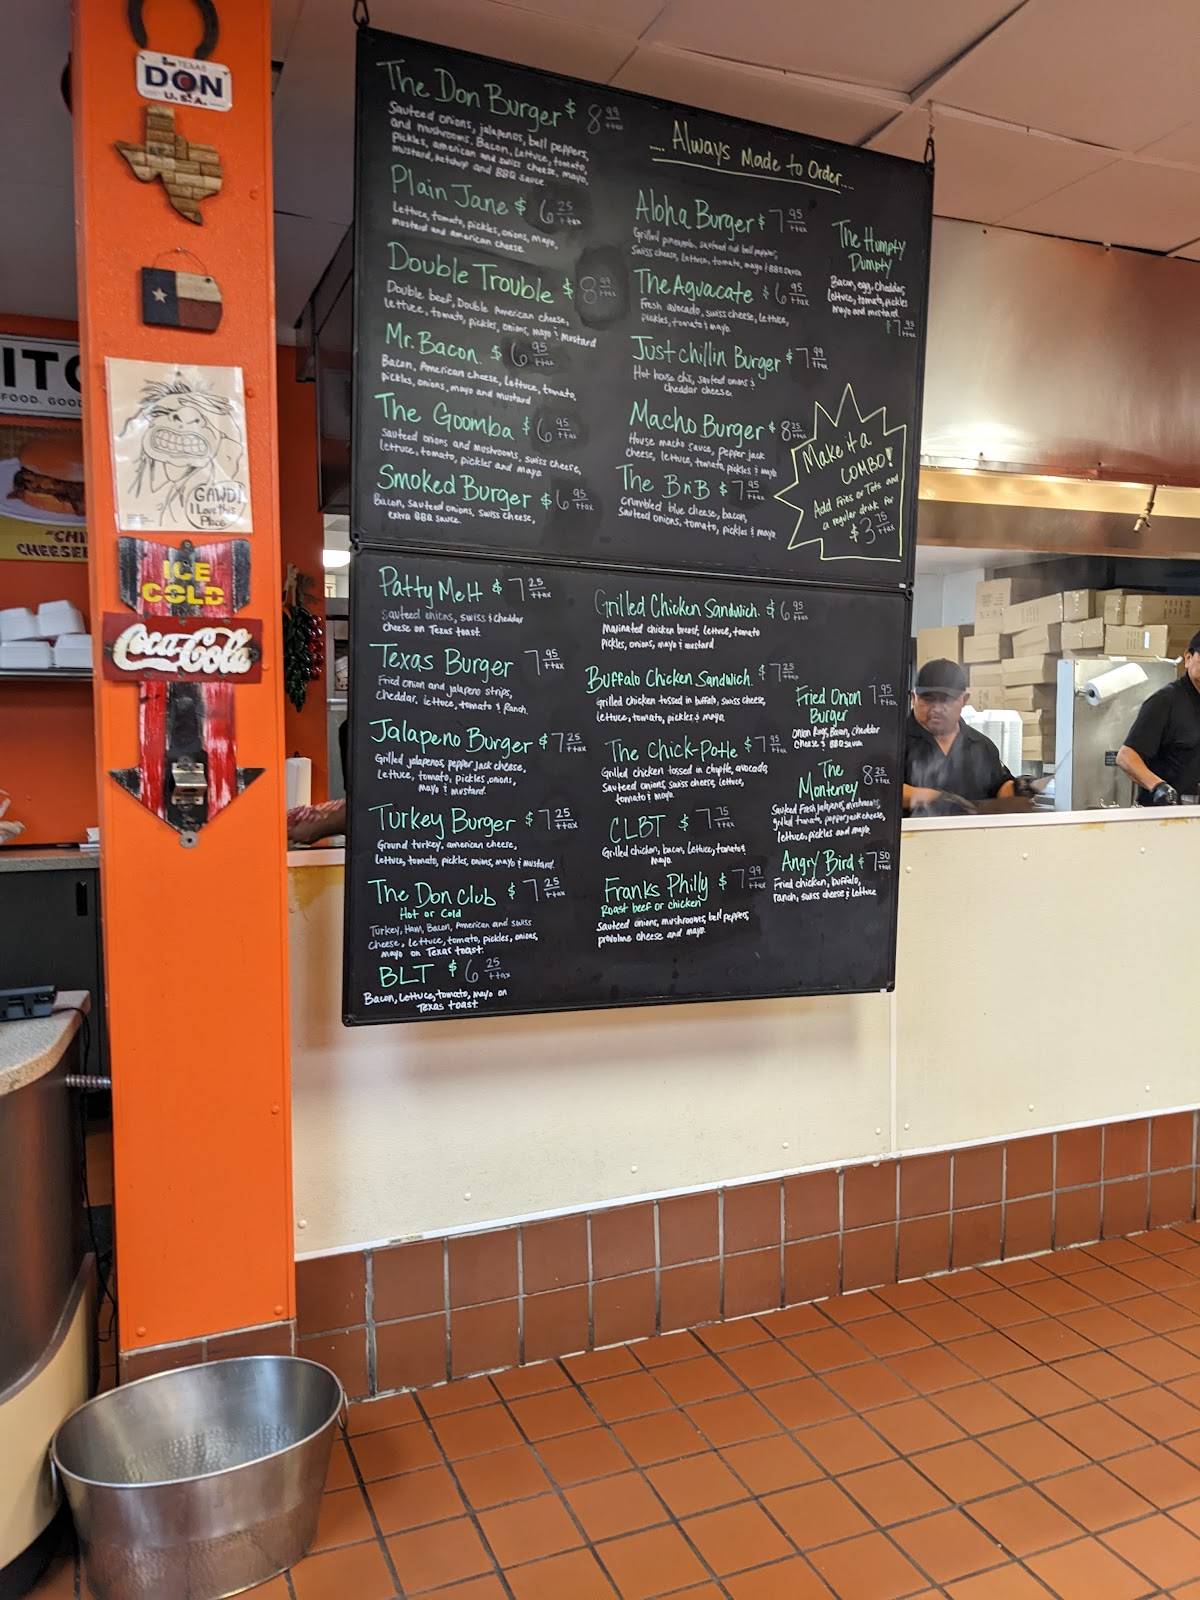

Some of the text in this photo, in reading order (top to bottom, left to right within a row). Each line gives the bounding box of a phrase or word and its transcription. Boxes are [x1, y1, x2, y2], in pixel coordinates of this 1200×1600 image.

[145, 65, 223, 97] DON
[377, 60, 562, 132] The Don Burger
[528, 133, 547, 149] bell
[672, 120, 730, 166] Always
[741, 149, 781, 172] Made
[786, 153, 802, 177] to
[473, 163, 491, 176] and
[390, 164, 509, 216] Plain Jane
[636, 189, 755, 242] Aloha Burger
[431, 225, 446, 236] and
[832, 220, 906, 260] The Humpty
[387, 241, 554, 304] Double Trouble
[848, 253, 892, 279] Dumpty
[386, 280, 489, 314] Double Double
[634, 268, 753, 305] The Aguacate
[640, 298, 662, 310] Fresh
[853, 307, 865, 315] and
[385, 322, 415, 349] Mr.
[630, 335, 676, 363] Just
[734, 344, 781, 380] Burger
[420, 361, 465, 378] American
[634, 364, 651, 380] Hot
[450, 384, 531, 405] mayo and mustard
[374, 392, 515, 441] The Goomba
[630, 398, 766, 448] Macho Burger
[453, 440, 469, 451] and
[629, 432, 686, 448] House macho
[803, 444, 844, 474] Make
[860, 433, 872, 448] a
[495, 463, 511, 472] and
[841, 447, 893, 484] COMBO!
[376, 463, 532, 512] Smoked Burger
[616, 463, 654, 493] The
[668, 501, 686, 516] blue
[814, 499, 832, 518] Add
[856, 490, 863, 498] or
[864, 481, 881, 494] Tots
[823, 501, 879, 530] a regular drink
[722, 524, 748, 538] pickles
[163, 560, 211, 582] ICE
[142, 583, 224, 605] COLD
[378, 565, 483, 609] Patty Melt
[594, 588, 646, 619] Grilled
[650, 592, 701, 617] Chicken
[414, 625, 453, 636] on Texas
[647, 623, 675, 634] chicken
[113, 623, 252, 673] Coca-Cola
[657, 640, 677, 651] mayo
[369, 643, 514, 684] Texas Burger
[378, 674, 400, 686] Fried
[402, 679, 425, 690] onion
[428, 682, 445, 692] and
[585, 665, 641, 694] Buffalo
[645, 665, 693, 687] Chicken
[459, 699, 492, 711] tomato
[625, 694, 693, 706] chicken in
[795, 684, 862, 707] Fried Onion
[667, 712, 694, 724] pickles
[810, 708, 849, 728] Burger
[368, 718, 534, 760] Jalapeno Burger
[374, 751, 474, 770] Grilled pepper
[604, 738, 639, 763] The
[601, 766, 703, 779] Grilled chicken in
[817, 759, 844, 778] The
[367, 803, 517, 840] Turkey Burger
[609, 814, 666, 844] CLBT
[377, 839, 409, 851] Ground
[601, 846, 629, 860] Grilled
[781, 849, 854, 879] Angry Bird
[604, 871, 710, 904] Franks Philly
[773, 877, 793, 889] Fried
[367, 879, 497, 909] The Don Club
[399, 907, 462, 919] Hot or Cold
[600, 899, 701, 918] Roast beef or chicken
[708, 910, 722, 922] bell
[455, 920, 491, 930] American
[492, 918, 508, 928] and
[482, 932, 514, 944] pickles,
[636, 930, 683, 942] cheese and
[410, 945, 452, 958] on Texas
[379, 963, 434, 989] BLT
[363, 988, 508, 1006] Bacon, mayo on
[417, 1002, 444, 1013] Texas
